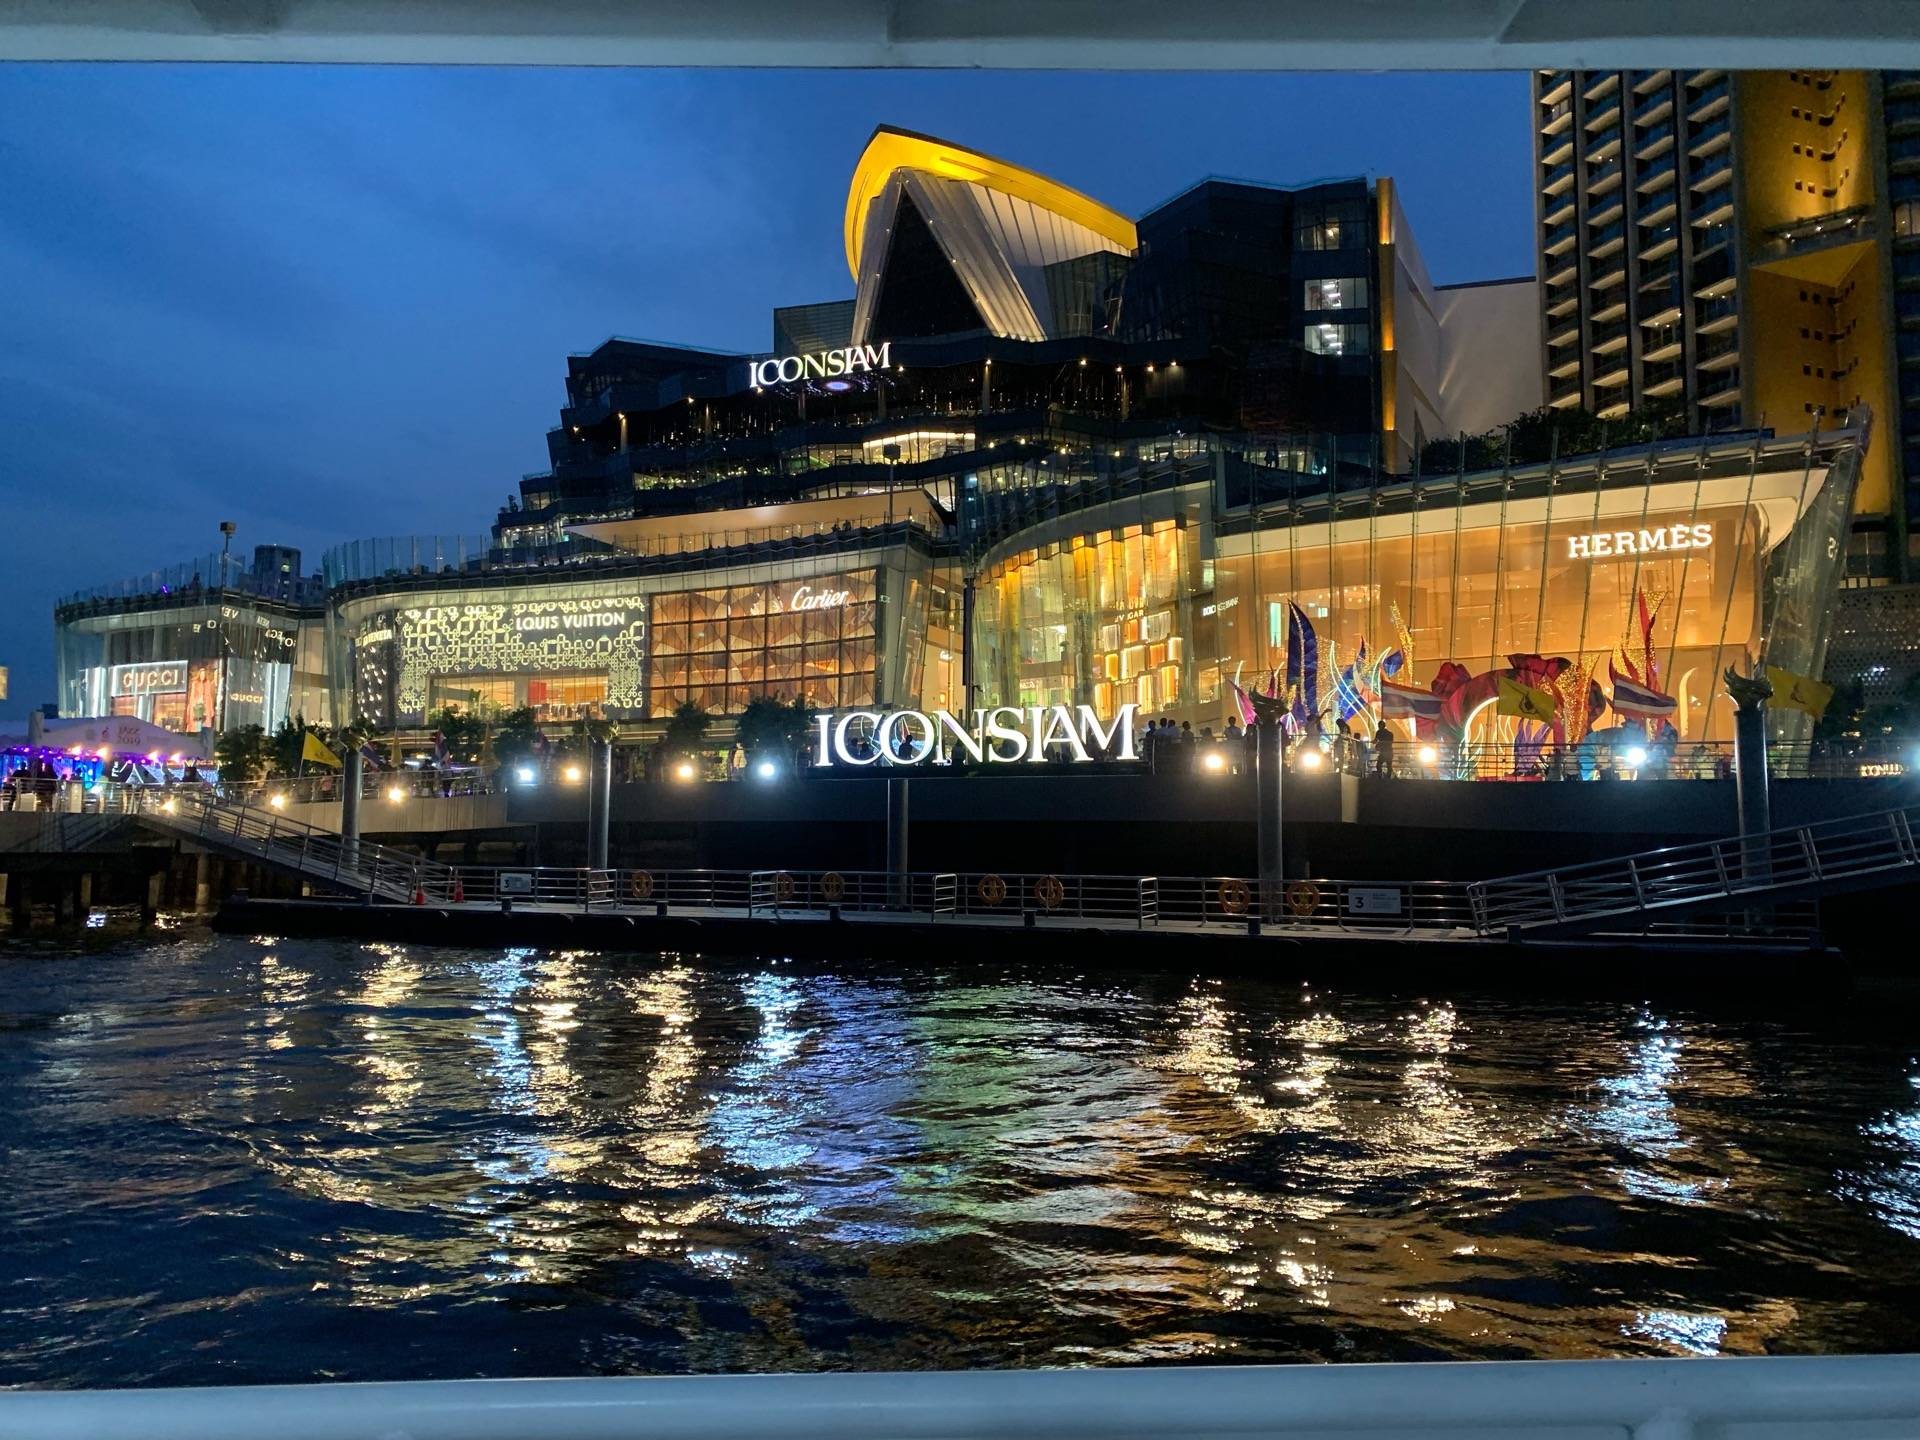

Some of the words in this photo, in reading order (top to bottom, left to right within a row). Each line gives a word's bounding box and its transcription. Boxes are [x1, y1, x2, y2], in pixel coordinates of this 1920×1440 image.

[749, 342, 891, 388] ICONSIAM
[1567, 523, 1713, 559] HERMÈS
[790, 586, 849, 611] Cartier
[516, 615, 559, 631] LOUIS
[562, 612, 625, 629] VUITTON
[122, 668, 179, 688] GUCCI
[814, 703, 1141, 768] ICONSIAM
[1354, 896, 1365, 909] 3
